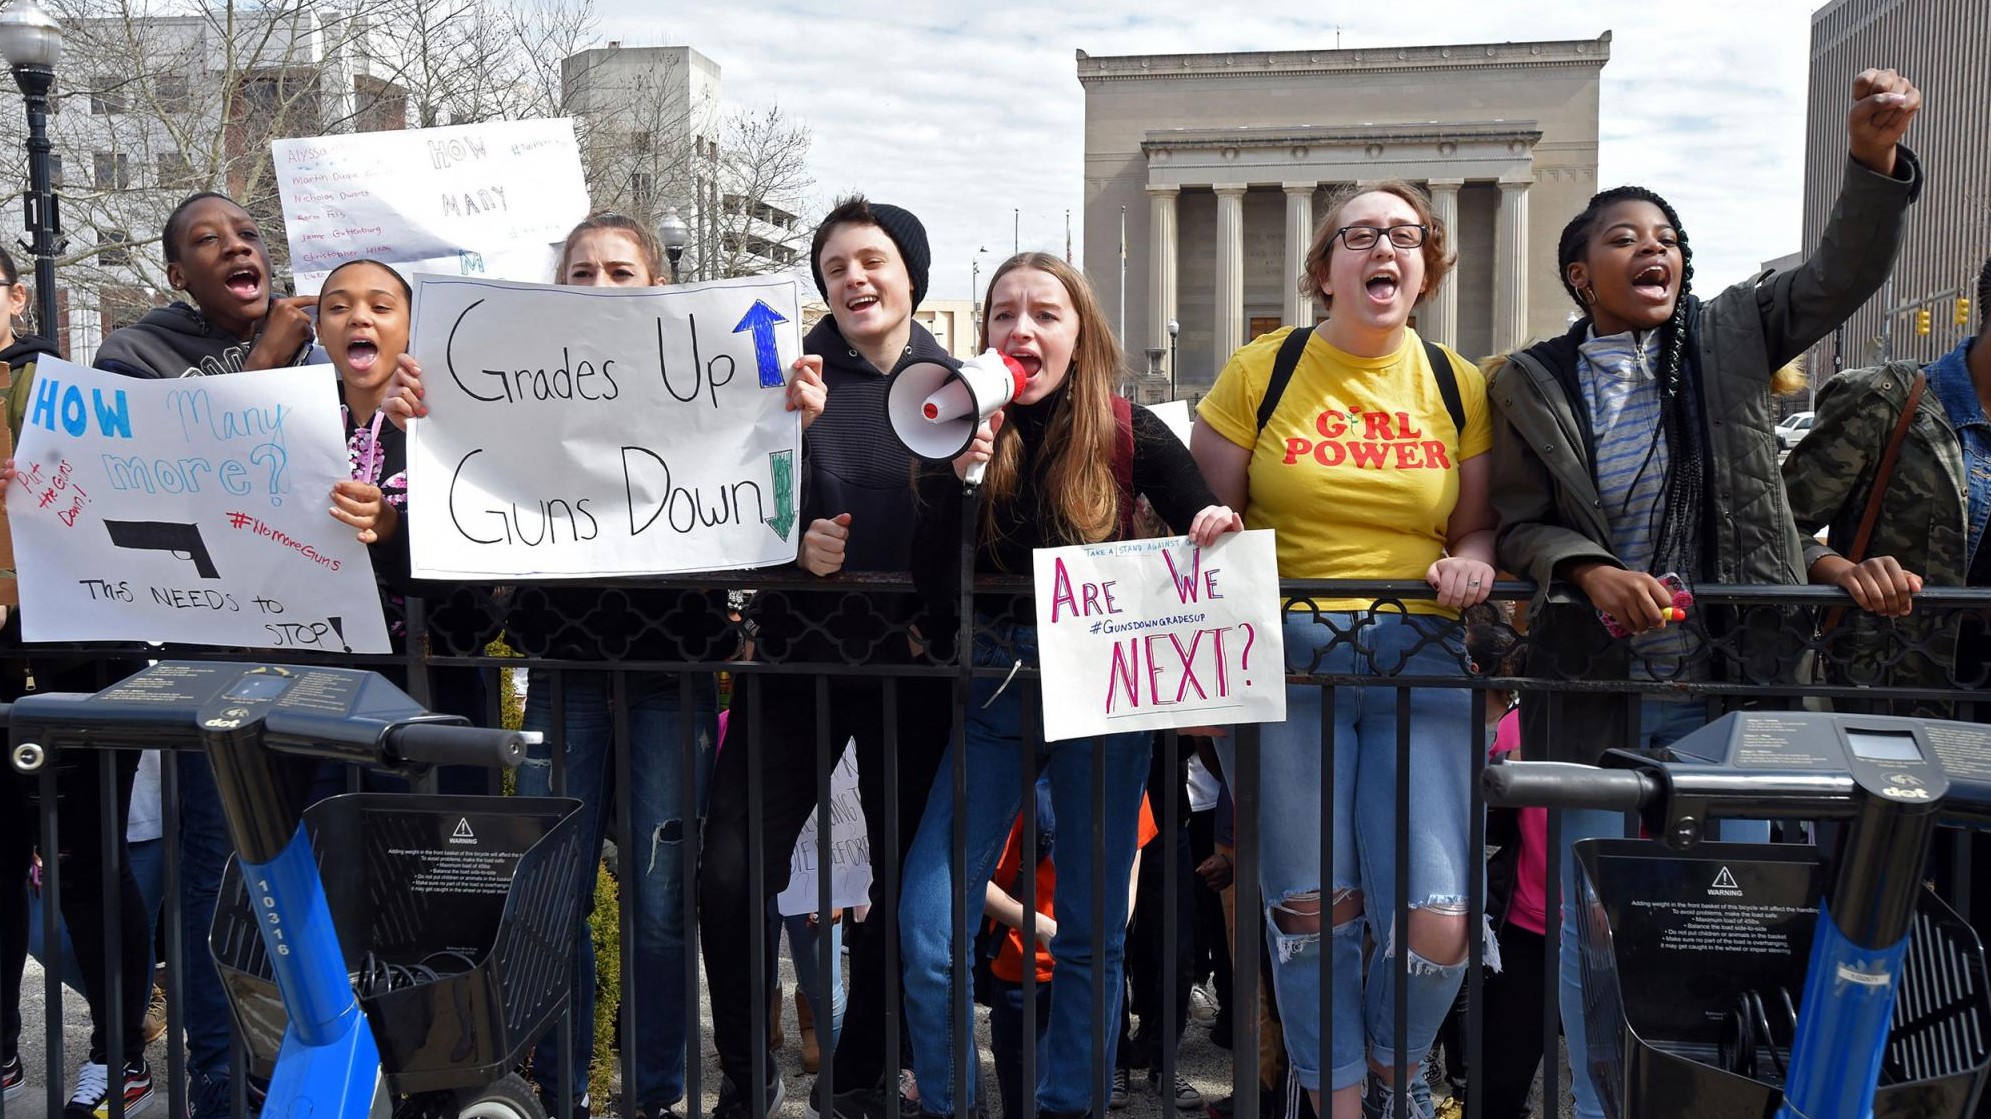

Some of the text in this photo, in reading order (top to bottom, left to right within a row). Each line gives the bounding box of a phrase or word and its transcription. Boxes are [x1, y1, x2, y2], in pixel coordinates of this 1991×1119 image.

[427, 136, 486, 169] HOW
[30, 198, 38, 225] 1
[446, 298, 736, 409] Grades Up
[32, 378, 294, 460] HOW Many
[1282, 437, 1452, 470] POWER
[17, 461, 47, 494] Put
[102, 443, 287, 507] more?
[449, 446, 765, 546] Guns Down
[150, 587, 241, 612] NEEDS
[265, 616, 353, 653] STOP!
[1106, 623, 1255, 714] NEXT?
[204, 718, 241, 729] dot
[1882, 786, 1930, 800] dot
[258, 879, 290, 956] 10316
